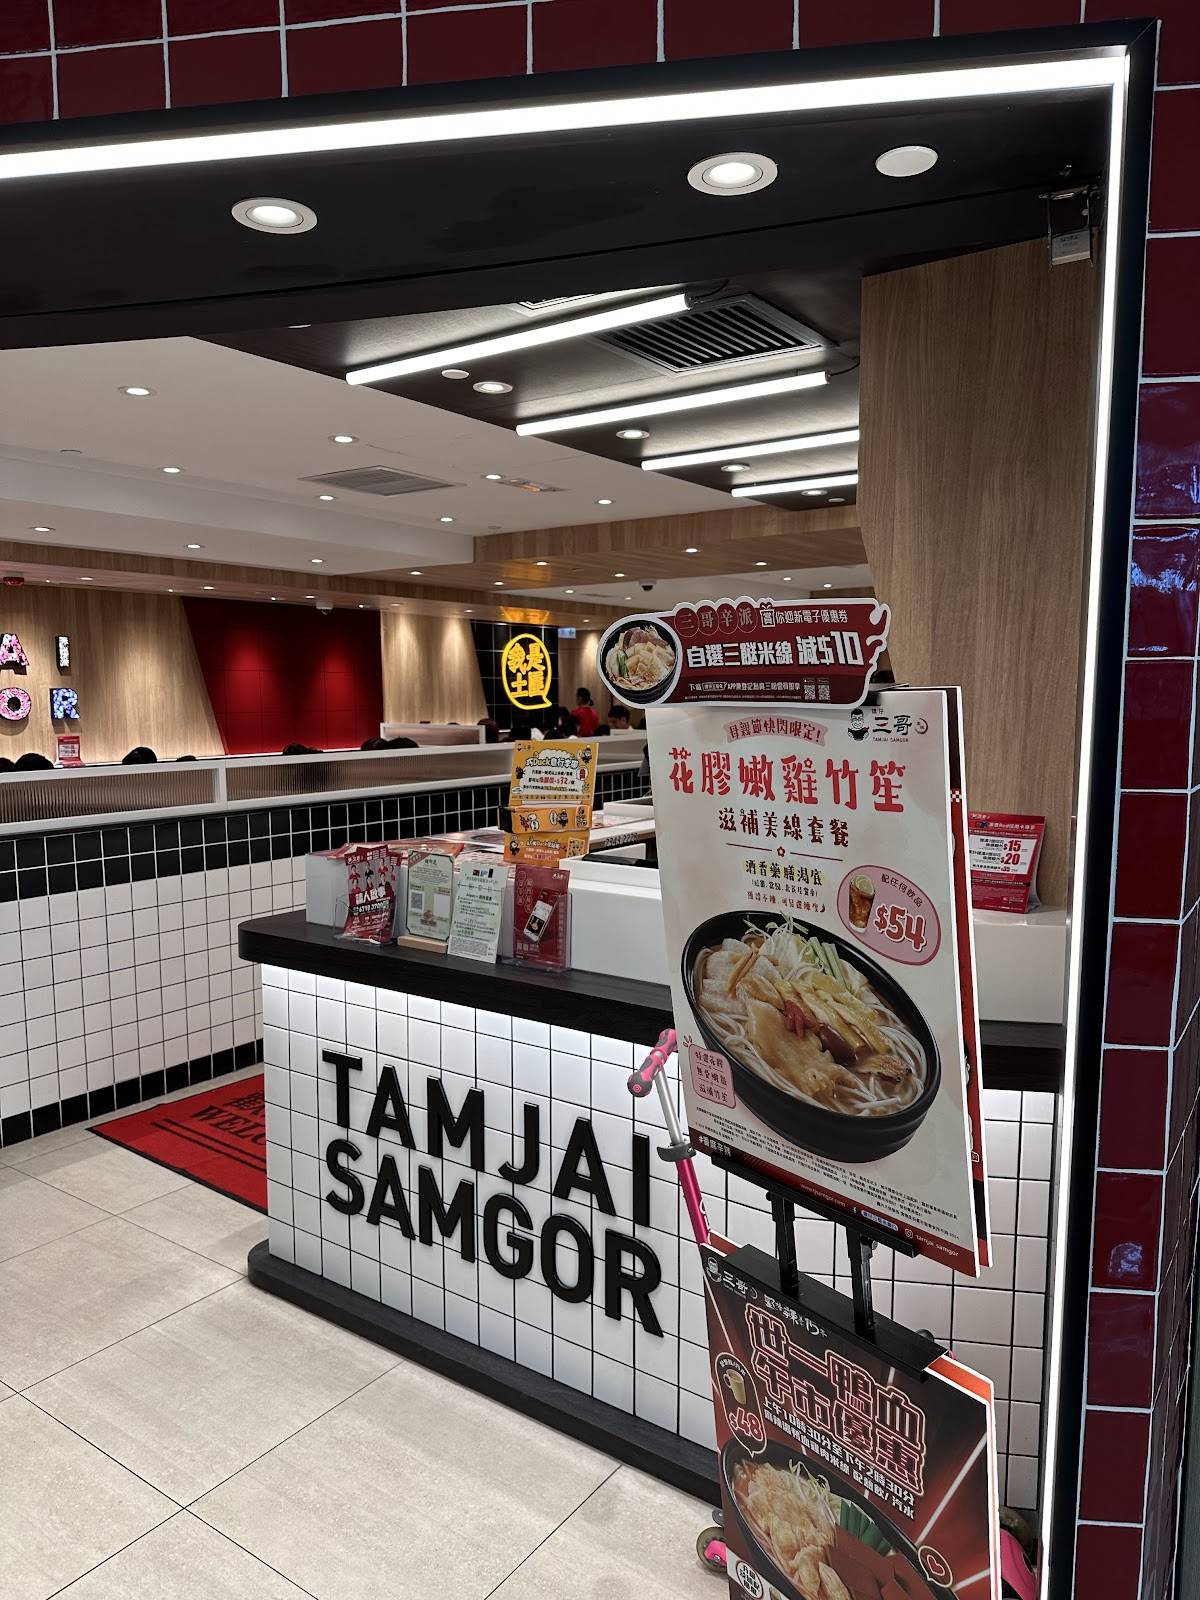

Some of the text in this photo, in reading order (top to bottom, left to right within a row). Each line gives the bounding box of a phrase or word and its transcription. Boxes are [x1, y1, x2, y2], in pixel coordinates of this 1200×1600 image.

[507, 643, 546, 675] 我是
[796, 630, 865, 667] 減$10
[872, 714, 913, 736] 三哥
[668, 746, 906, 814] 花膠嫩雞竹笙
[718, 808, 850, 848] 滋補美線套餐
[1003, 839, 1022, 853] $15
[1000, 853, 1021, 866] $20
[881, 873, 923, 908] 配任何飲品
[874, 904, 927, 952] $54
[322, 1049, 650, 1228] TAMJAI
[325, 1139, 664, 1338] SAMGOR
[728, 1406, 763, 1442] $48
